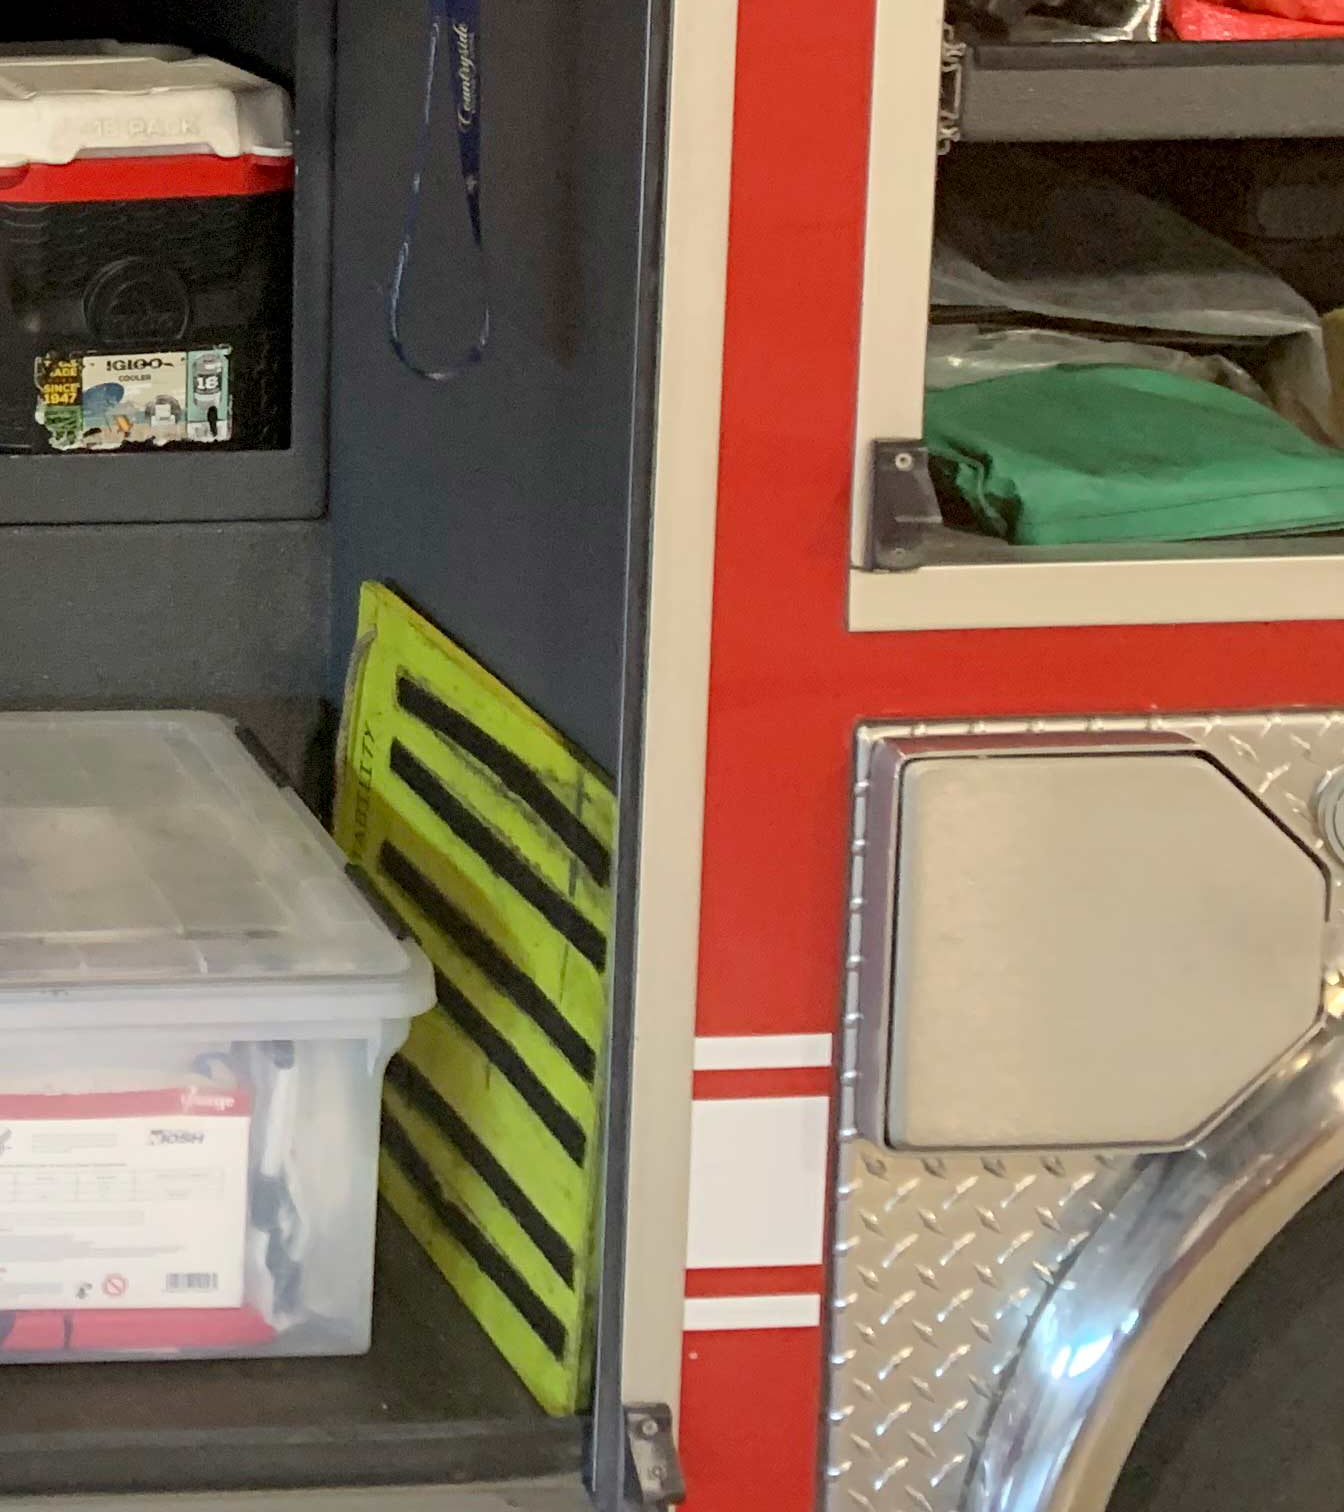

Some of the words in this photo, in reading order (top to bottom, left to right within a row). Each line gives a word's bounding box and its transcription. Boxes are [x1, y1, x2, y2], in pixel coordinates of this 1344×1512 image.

[118, 374, 152, 382] COOLER
[43, 383, 79, 393] SINCE
[43, 393, 77, 403] 1947
